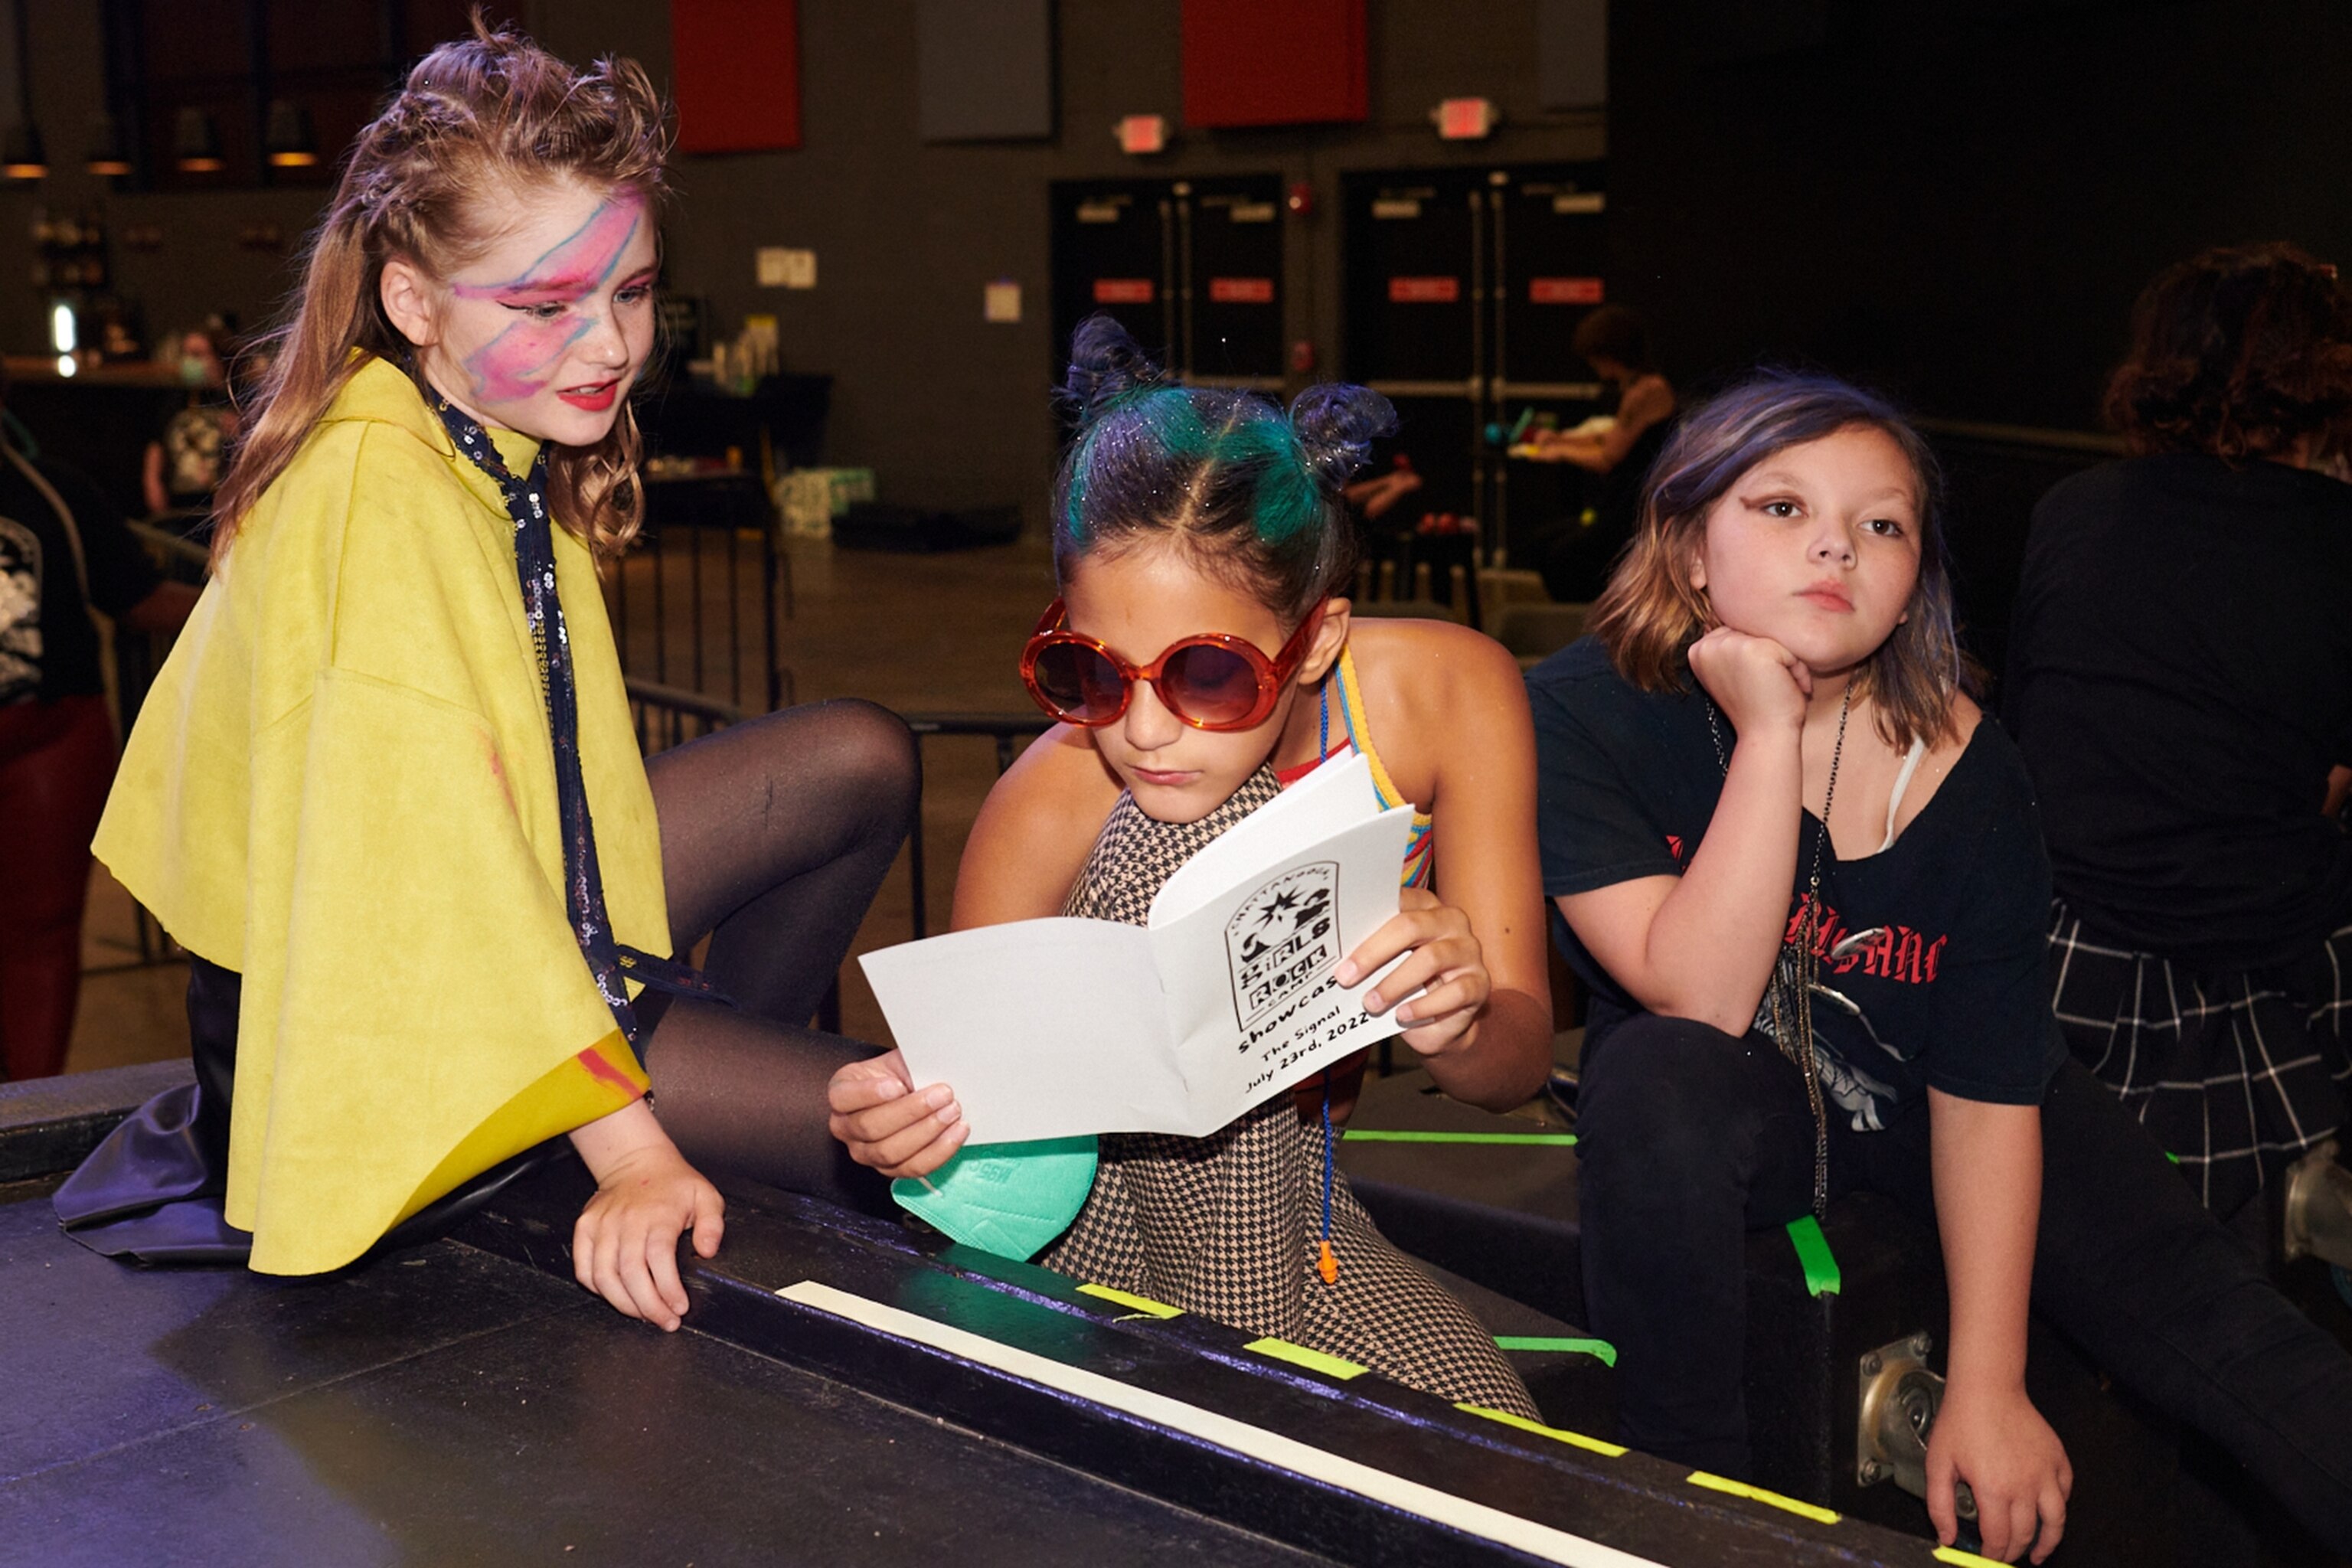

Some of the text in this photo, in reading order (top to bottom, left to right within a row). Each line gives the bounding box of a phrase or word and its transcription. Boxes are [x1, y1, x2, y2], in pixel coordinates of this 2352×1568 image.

[1249, 943, 1328, 1010] ROCK
[1268, 971, 1313, 1008] CAMP
[1238, 975, 1338, 1054] showcas
[1262, 1004, 1341, 1062] The Signal
[1245, 1069, 1274, 1094] July
[1326, 1011, 1370, 1042] 2022
